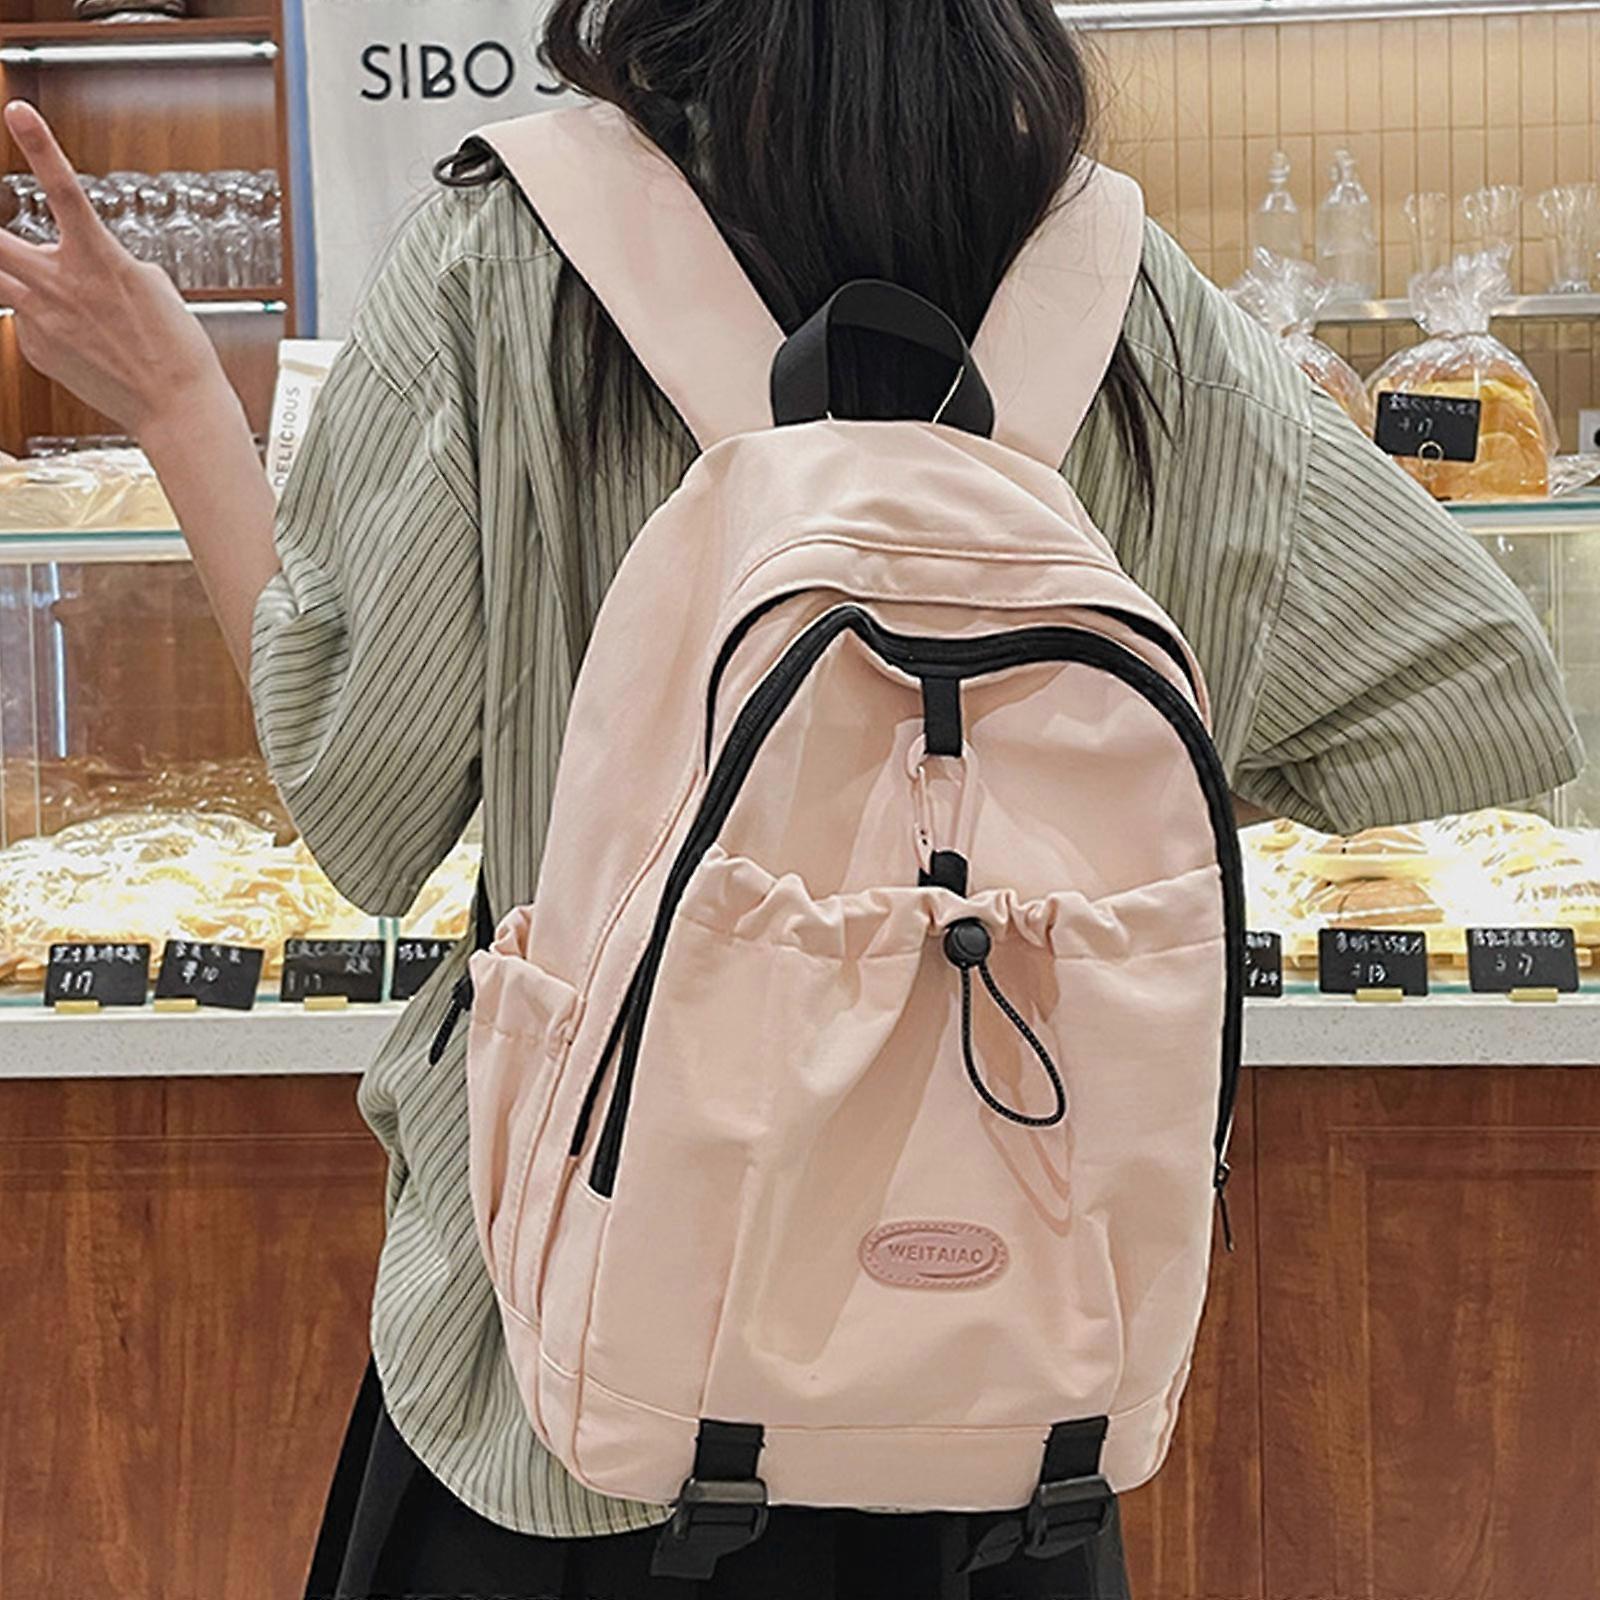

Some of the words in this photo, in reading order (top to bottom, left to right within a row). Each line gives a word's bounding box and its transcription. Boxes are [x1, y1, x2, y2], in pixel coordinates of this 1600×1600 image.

[360, 41, 515, 100] SIBO
[273, 385, 300, 488] DELICIOUS
[887, 1243, 984, 1266] WEITAIAO
